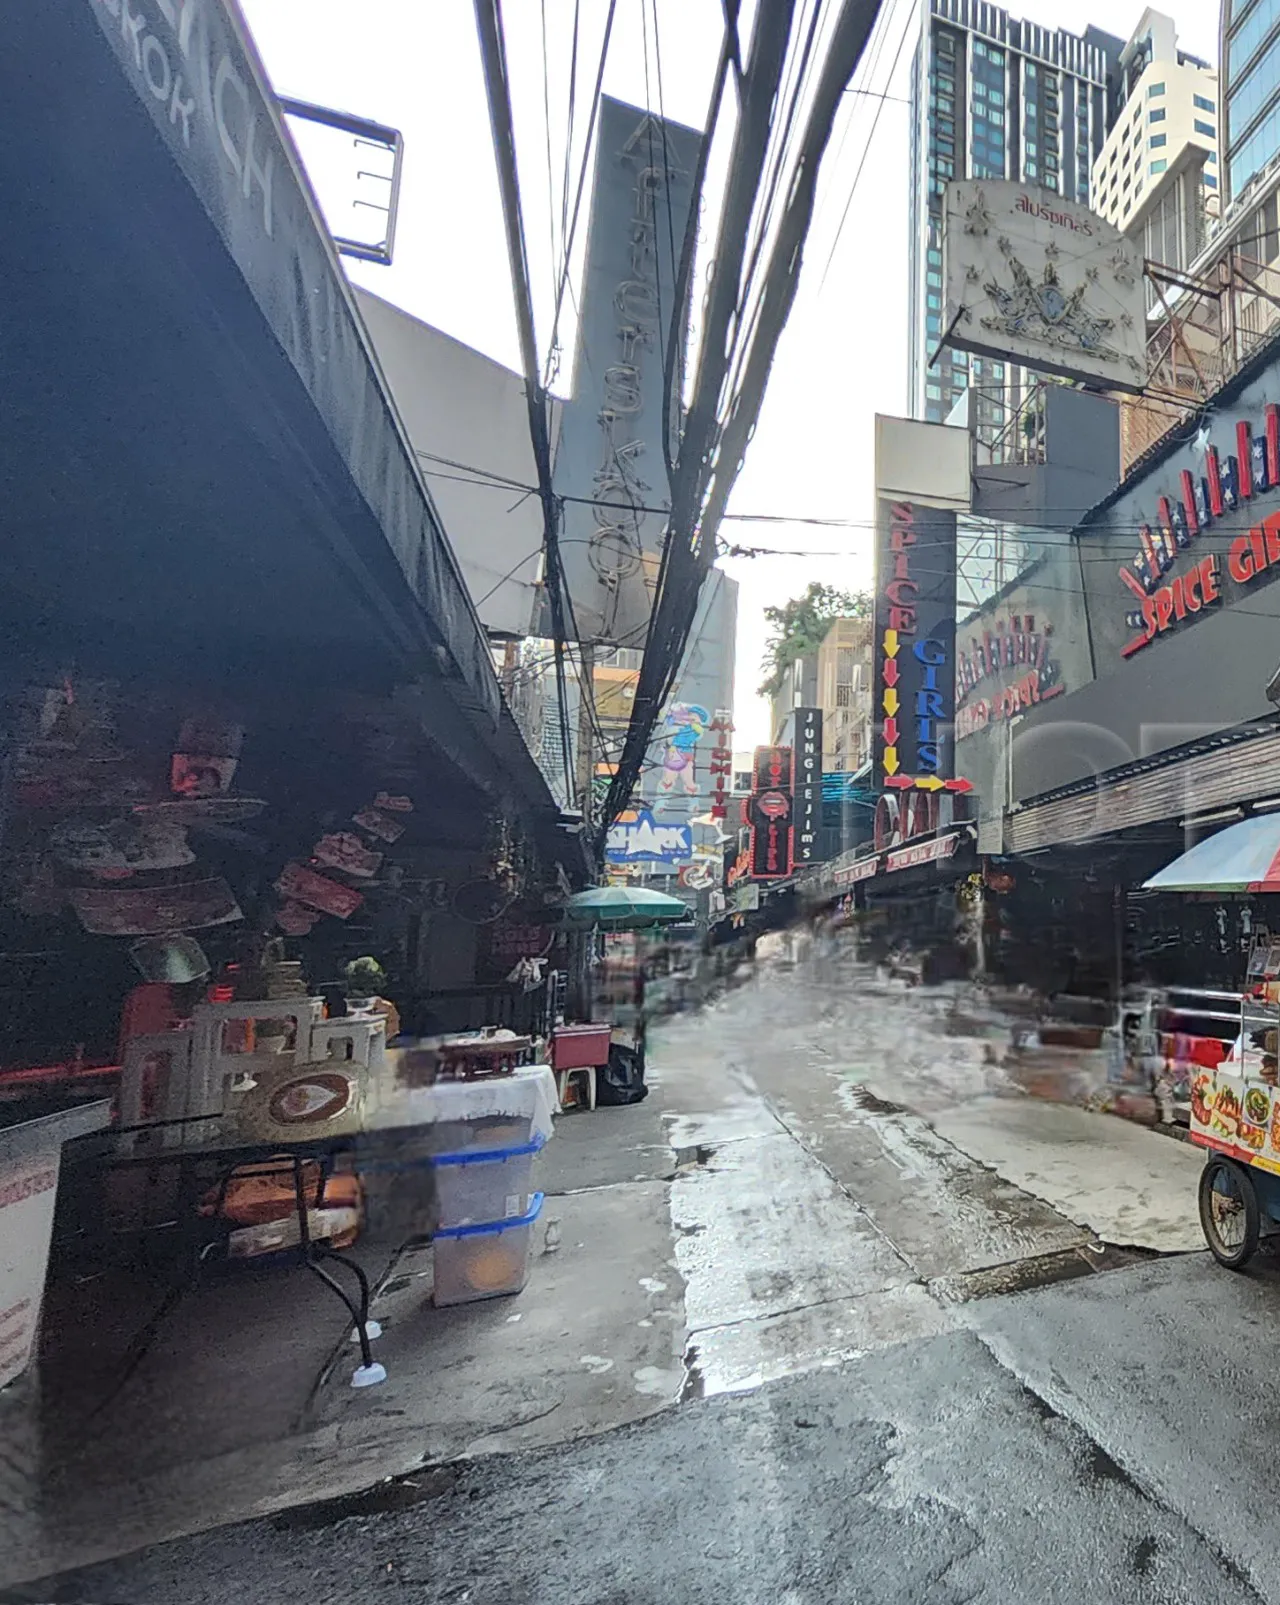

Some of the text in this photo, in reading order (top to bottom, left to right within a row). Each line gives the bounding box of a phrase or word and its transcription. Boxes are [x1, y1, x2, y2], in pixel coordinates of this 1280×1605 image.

[885, 501, 920, 635] SPICE
[912, 639, 946, 772] GIRLS
[1141, 554, 1222, 639] SPICE
